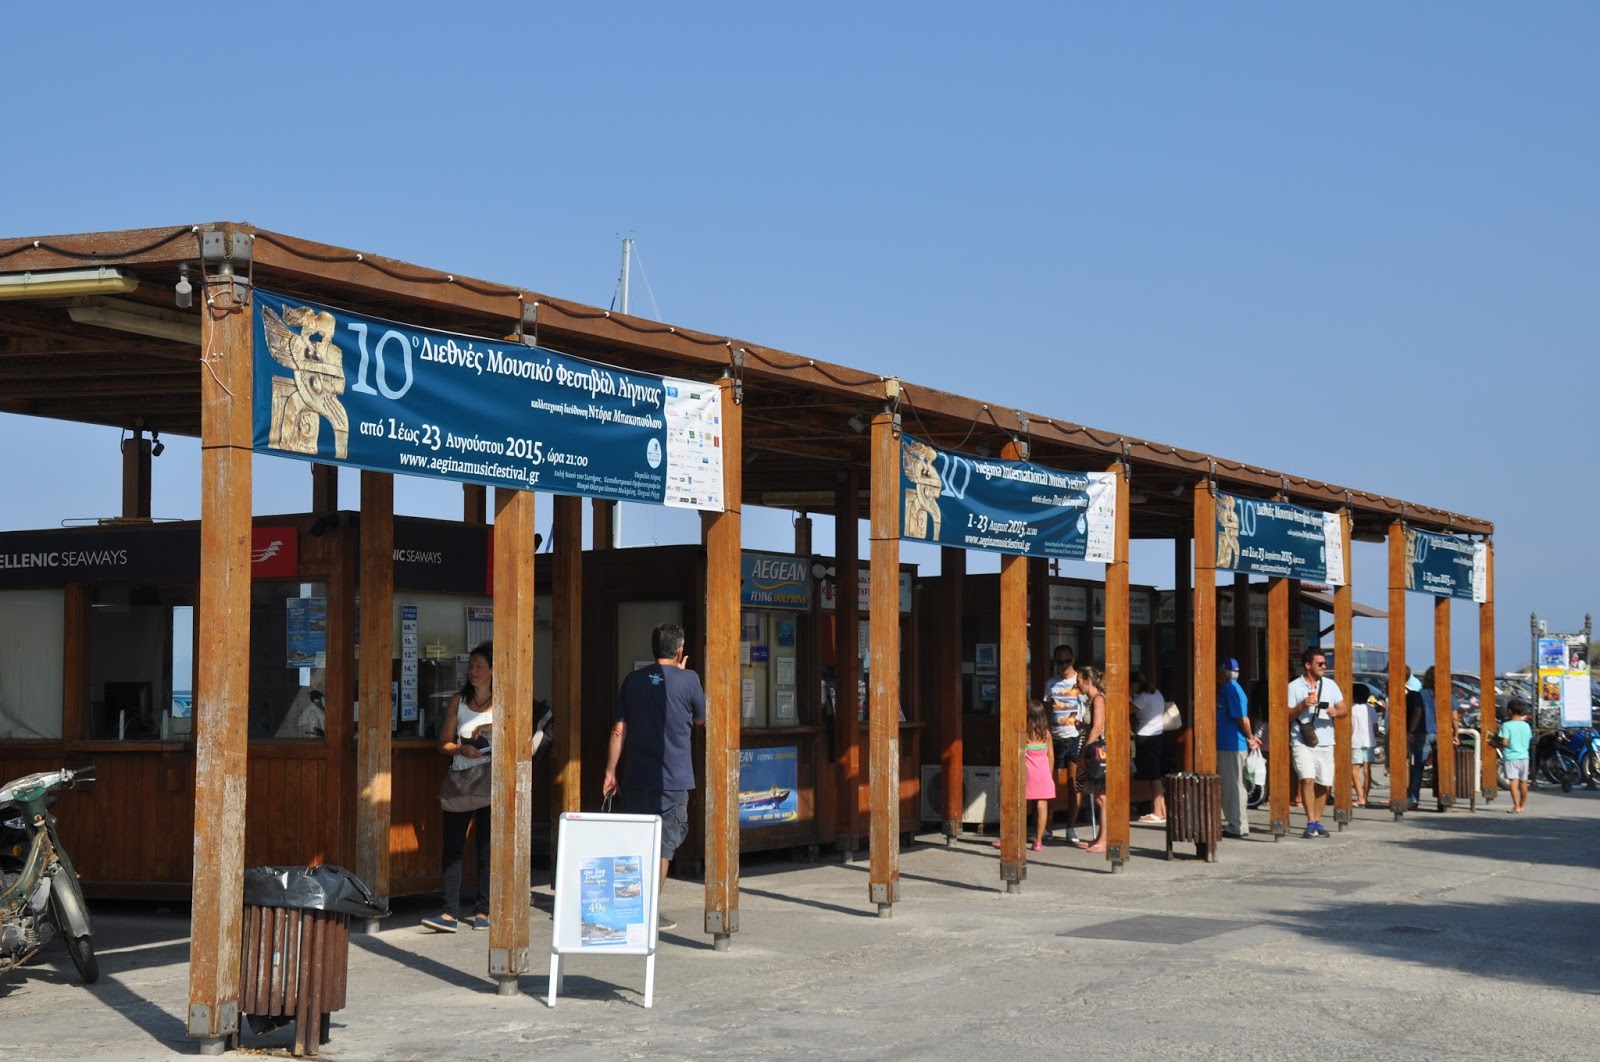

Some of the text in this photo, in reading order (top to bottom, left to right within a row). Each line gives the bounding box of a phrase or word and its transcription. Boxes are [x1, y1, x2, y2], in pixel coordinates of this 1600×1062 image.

[420, 336, 483, 375] Διεθνές
[486, 349, 553, 383] Μουσικό
[556, 363, 616, 399] Φεστιβάλ
[588, 404, 612, 424] Ντόρα
[612, 410, 662, 430] Μπακοπούλου
[360, 418, 384, 436] από
[421, 423, 441, 451] 23
[446, 432, 504, 454] Αυγούστου
[505, 436, 545, 466] 2015,
[548, 448, 564, 466] ώρα
[566, 454, 588, 466] 21:00
[399, 452, 540, 485] www.aeginamusicfestival.gr
[988, 520, 1008, 534] August
[62, 550, 128, 566] SEAWAYS
[406, 550, 442, 564] SEAWAYS
[752, 560, 806, 582] AEGEAN
[752, 590, 806, 604] FLYING DOLPHINS
[404, 636, 416, 644] 10.
[404, 650, 416, 658] 12.
[404, 706, 416, 716] 20.
[594, 868, 606, 876] Day
